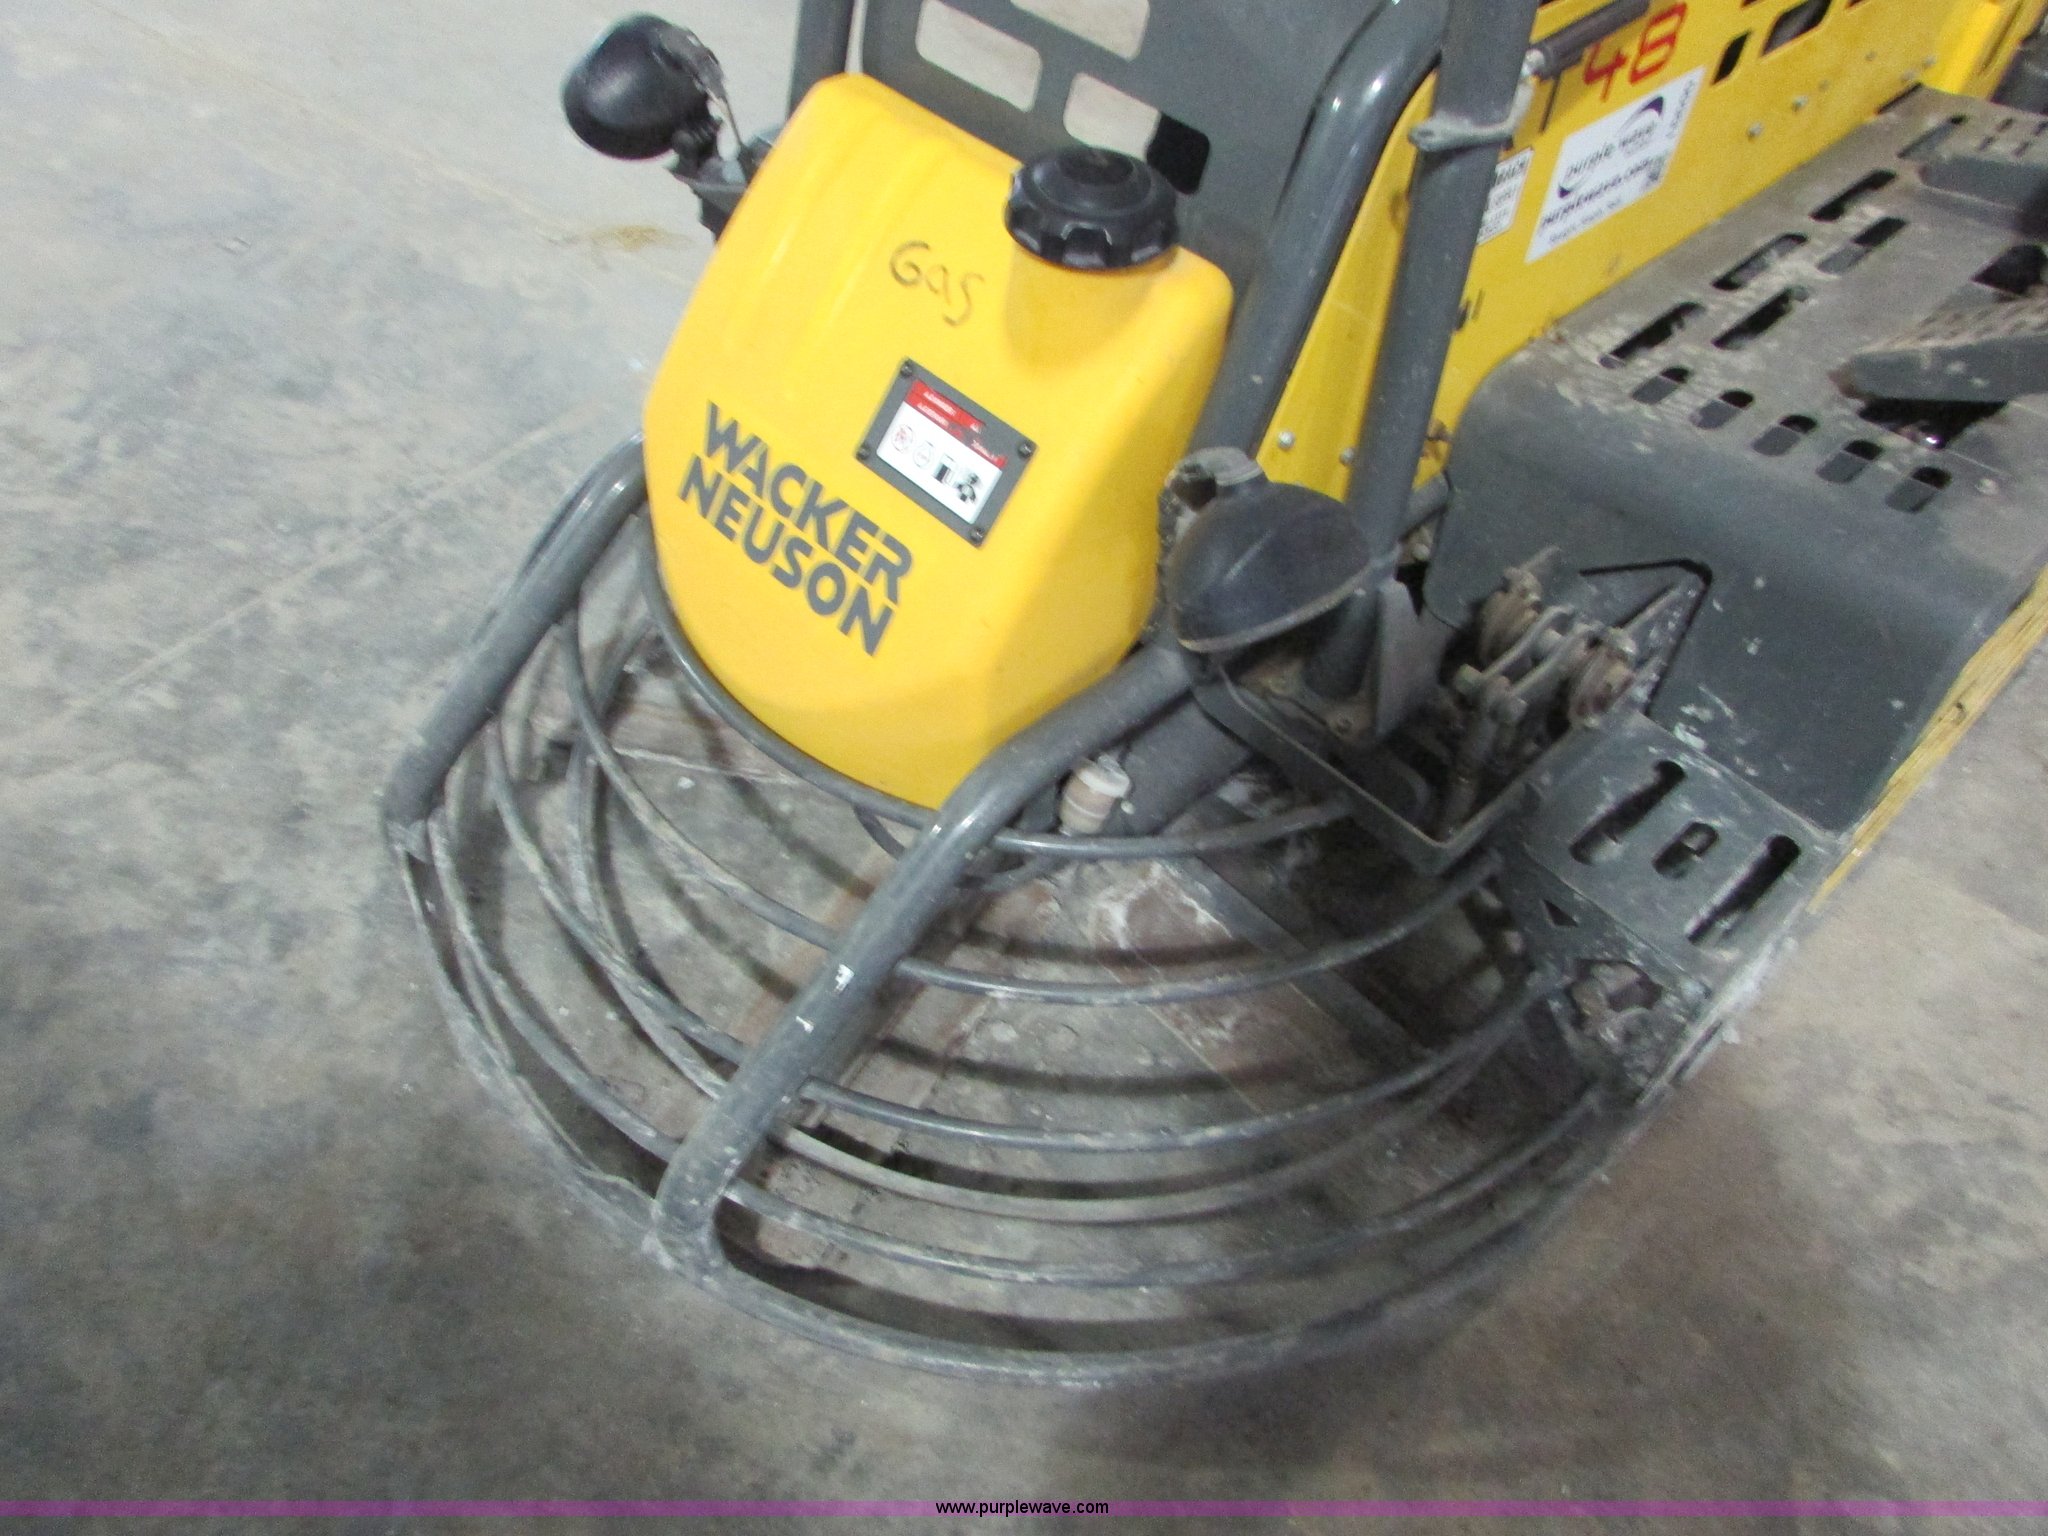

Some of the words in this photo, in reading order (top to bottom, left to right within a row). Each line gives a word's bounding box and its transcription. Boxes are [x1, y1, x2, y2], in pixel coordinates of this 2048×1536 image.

[1582, 1, 1688, 102] 48
[679, 453, 896, 657] NEUSON
[705, 399, 912, 604] WACKER
